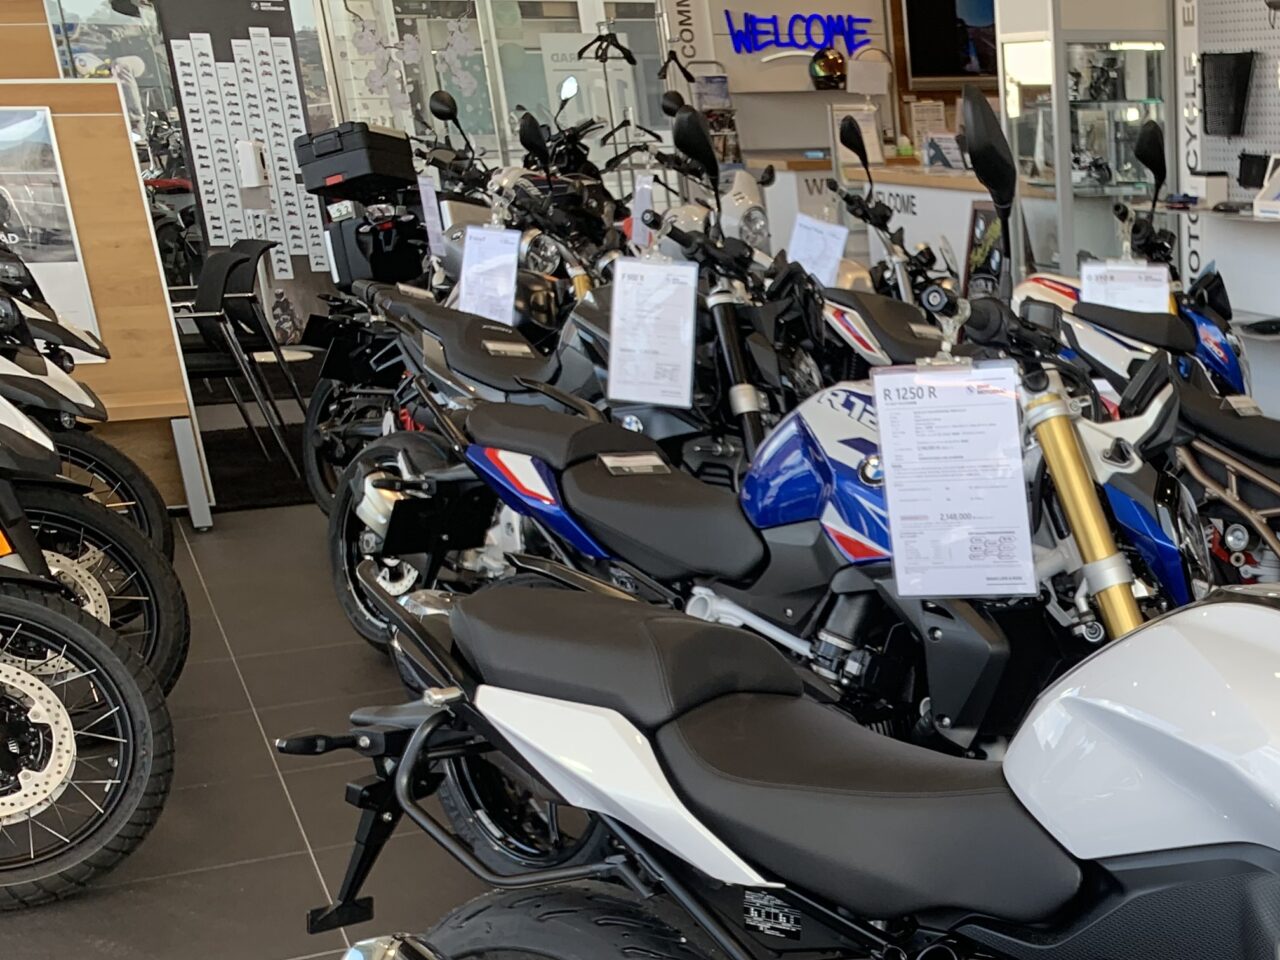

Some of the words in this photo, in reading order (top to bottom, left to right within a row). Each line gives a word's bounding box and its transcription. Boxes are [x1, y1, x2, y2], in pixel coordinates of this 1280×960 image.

[724, 9, 873, 57] WELCOME
[883, 388, 893, 401] R
[896, 386, 925, 401] 1250
[928, 385, 938, 399] R
